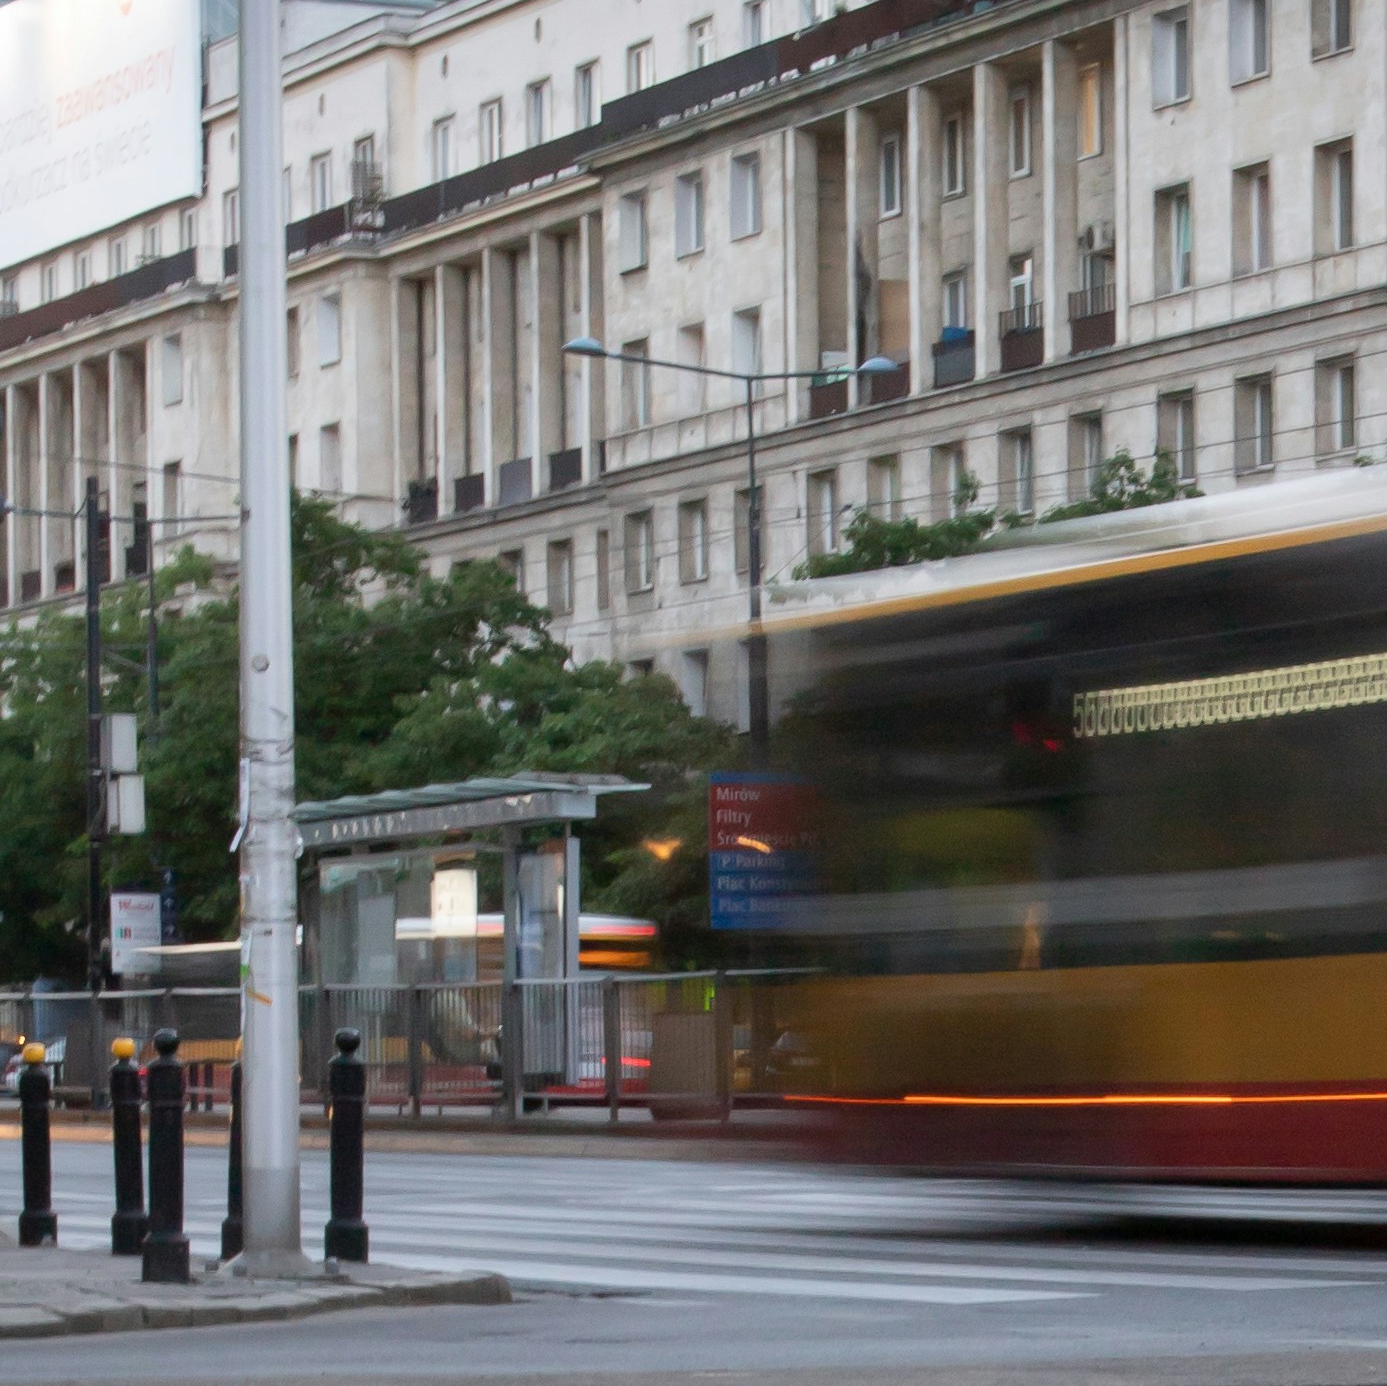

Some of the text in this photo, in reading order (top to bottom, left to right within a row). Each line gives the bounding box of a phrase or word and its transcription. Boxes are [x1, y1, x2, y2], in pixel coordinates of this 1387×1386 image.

[716, 786, 760, 802] Mirów
[716, 808, 752, 827] Filtry
[717, 875, 745, 891] Plac
